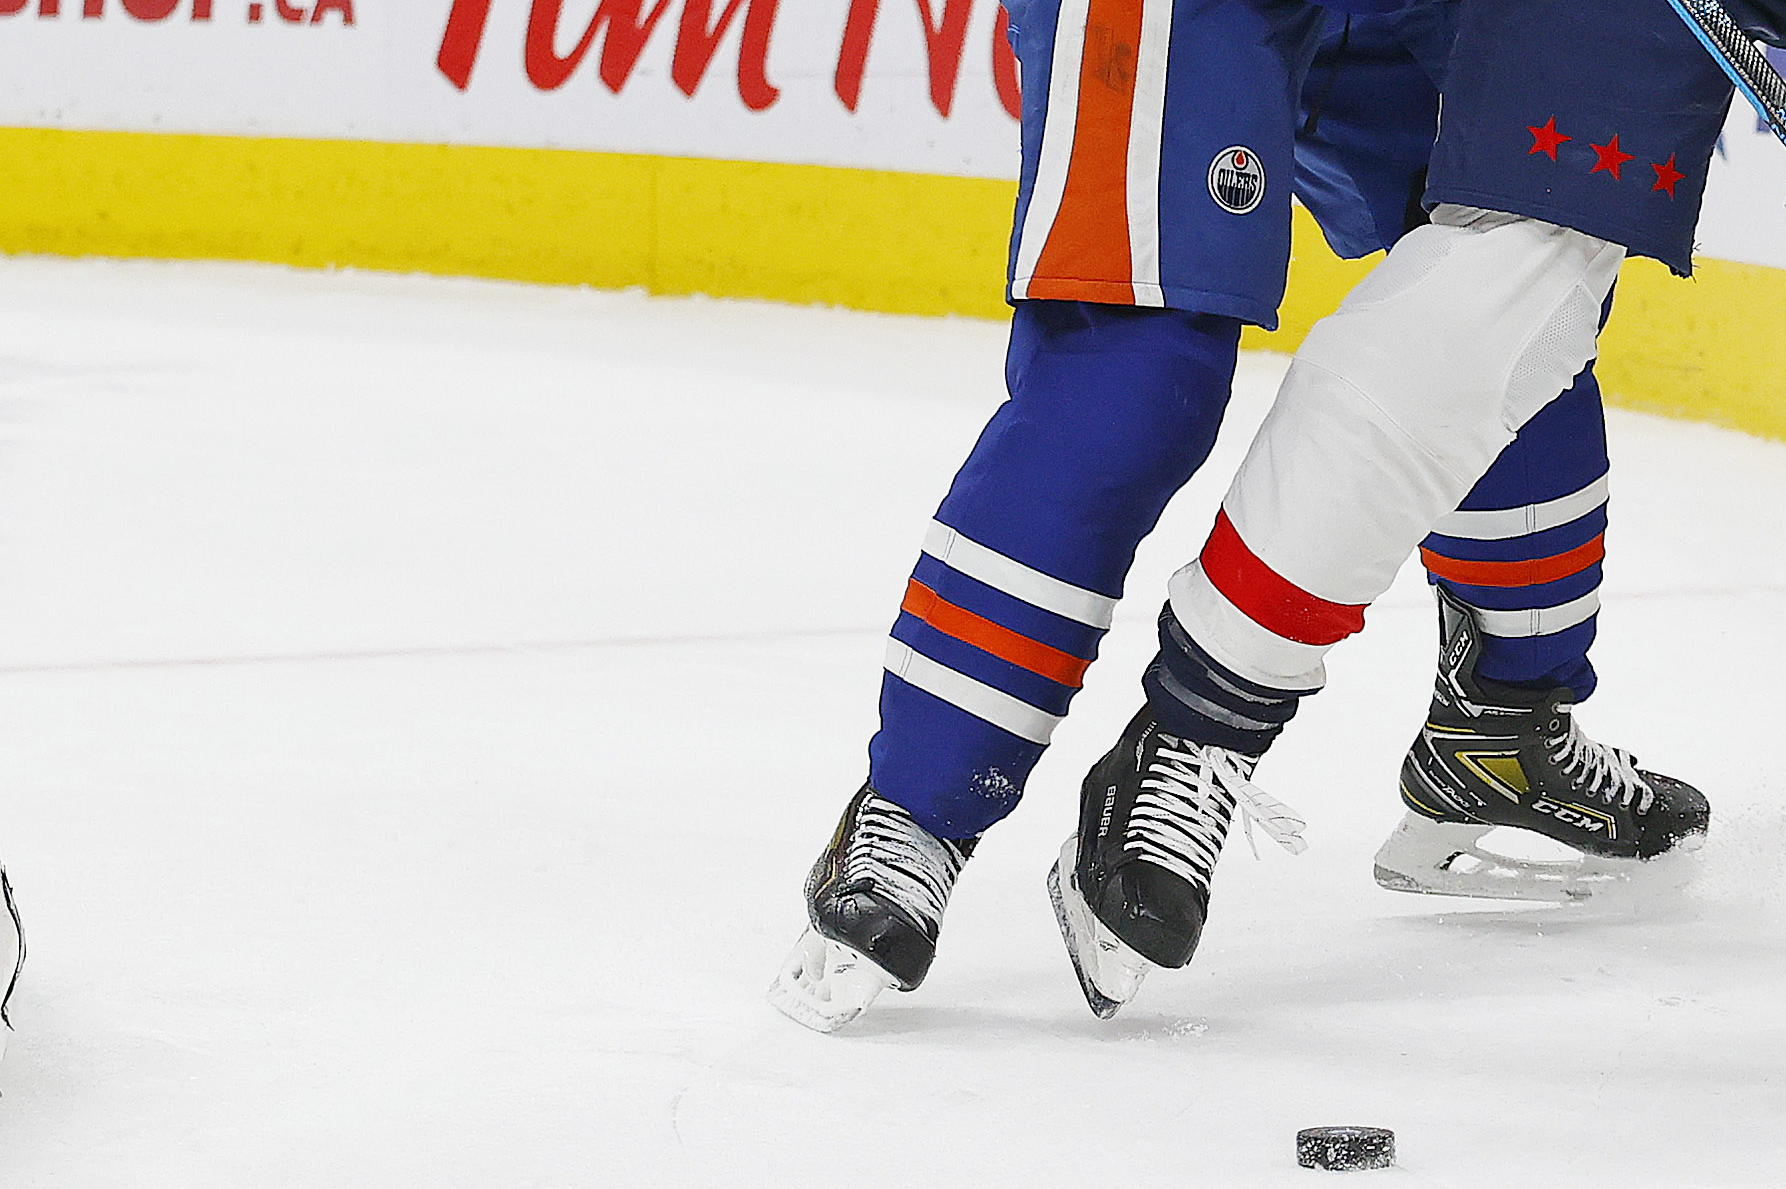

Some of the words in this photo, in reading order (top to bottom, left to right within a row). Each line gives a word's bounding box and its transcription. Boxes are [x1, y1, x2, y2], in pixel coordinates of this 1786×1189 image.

[1217, 168, 1258, 192] OILERS
[1448, 630, 1470, 668] CCM
[1097, 784, 1117, 838] BAUER
[1530, 799, 1606, 833] CCM
